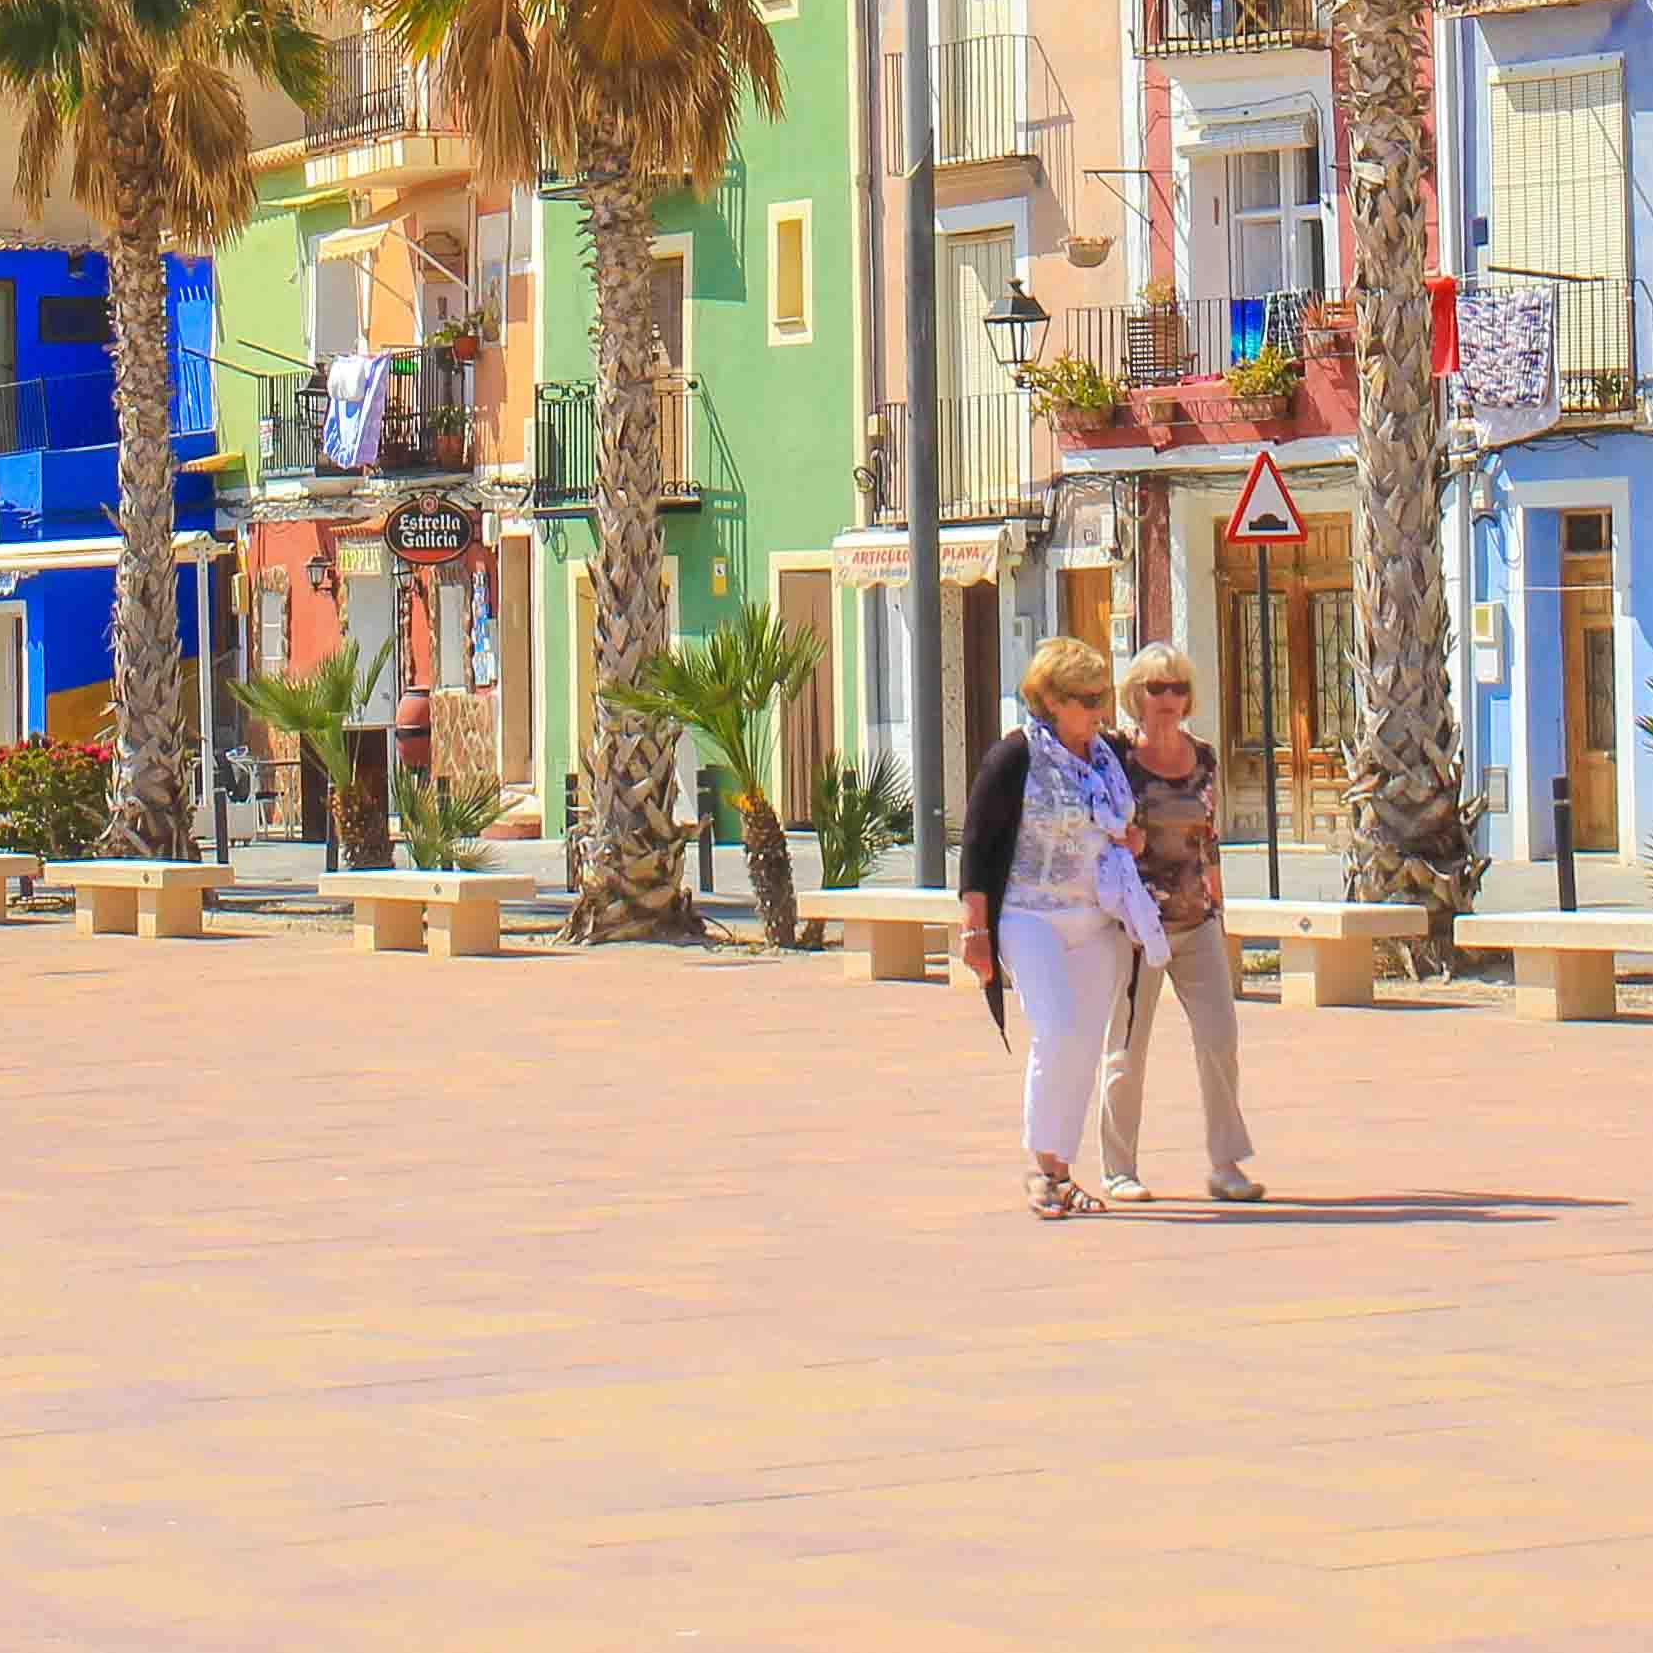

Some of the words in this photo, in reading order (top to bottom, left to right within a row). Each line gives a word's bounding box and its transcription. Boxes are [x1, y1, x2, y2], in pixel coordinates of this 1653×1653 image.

[398, 513, 461, 531] Estrella
[401, 530, 458, 548] Galicia
[852, 548, 909, 565] ARTICULO
[942, 545, 980, 560] PLAYA
